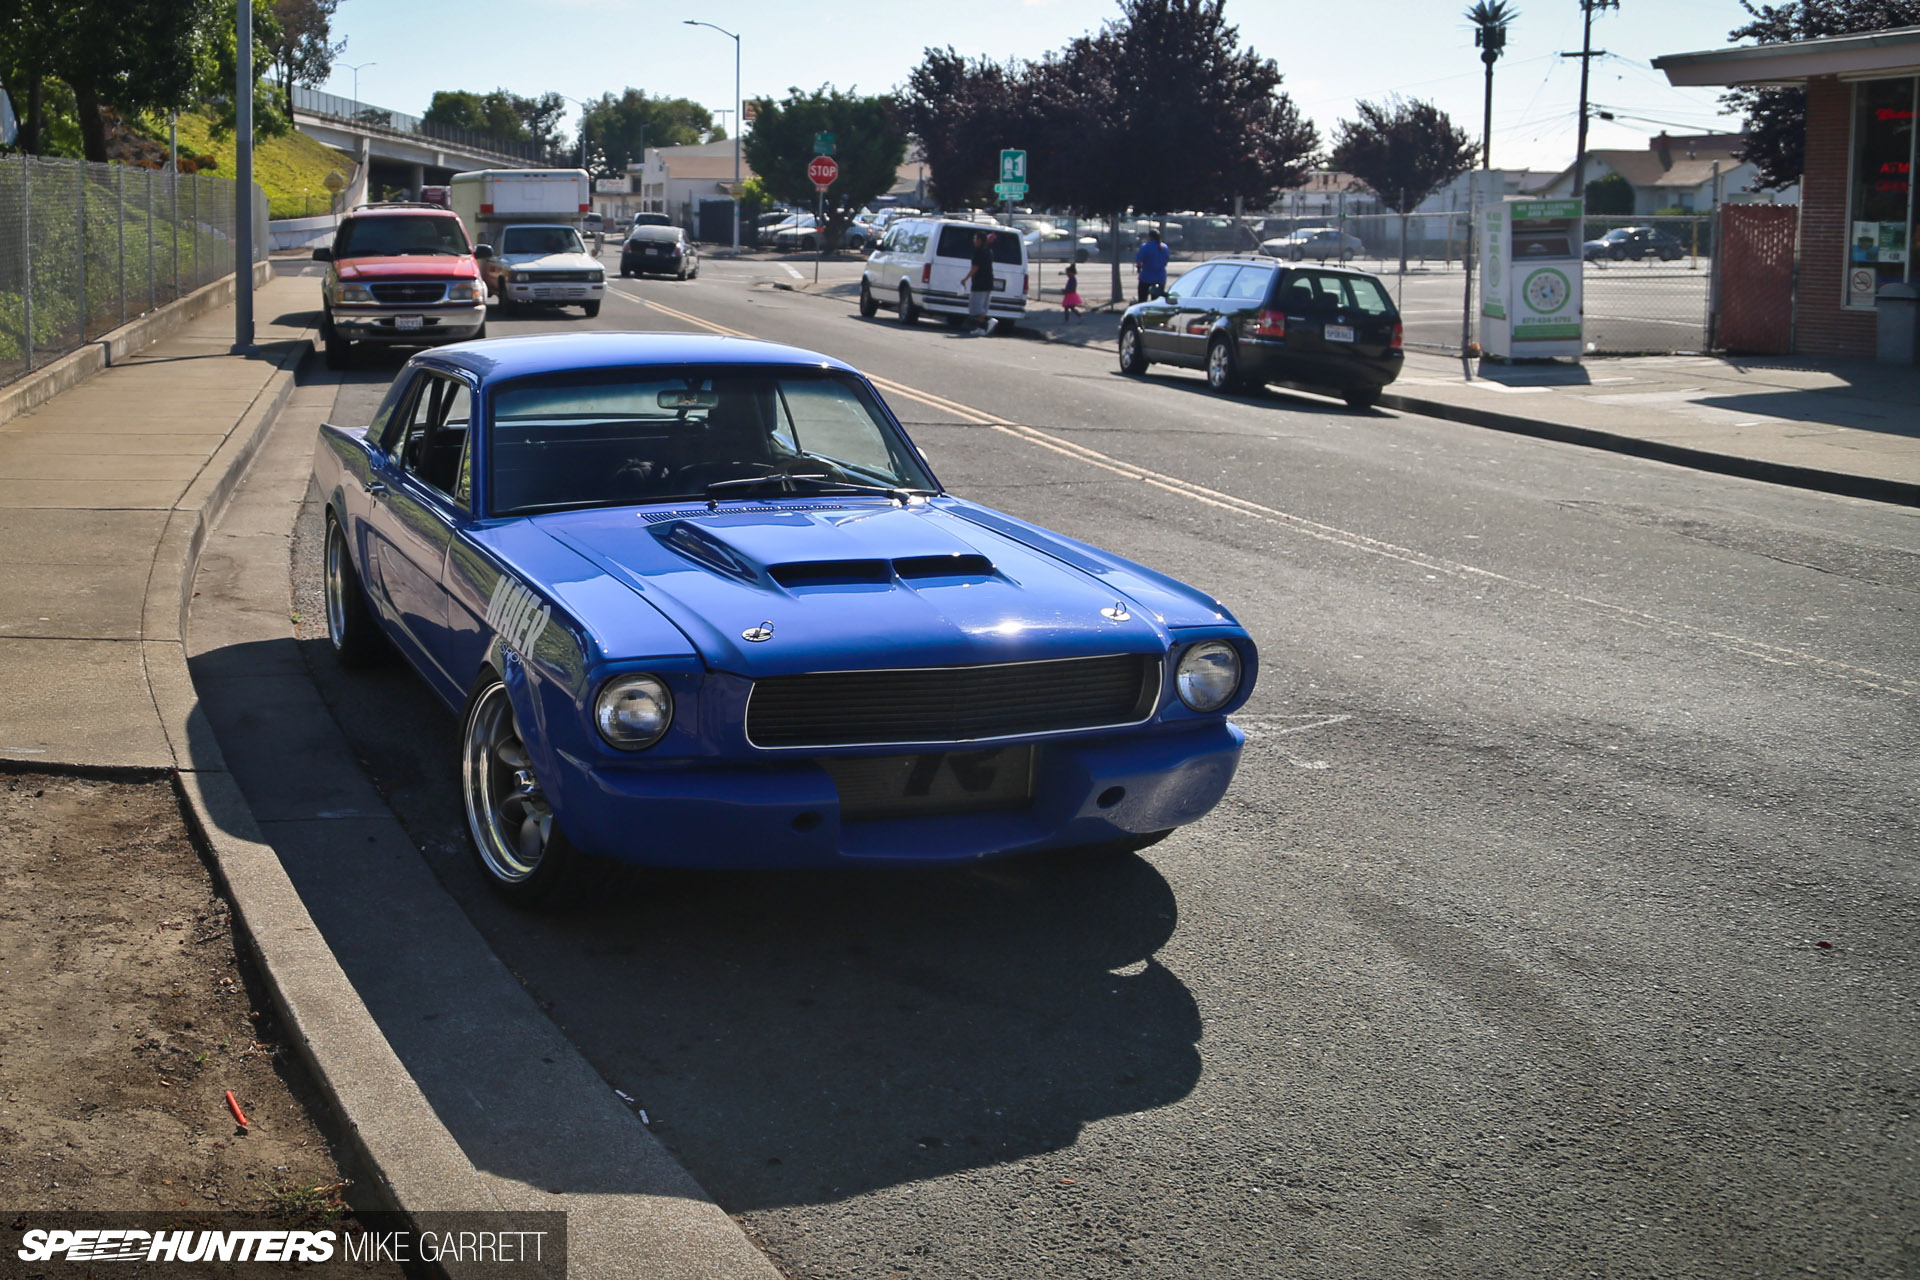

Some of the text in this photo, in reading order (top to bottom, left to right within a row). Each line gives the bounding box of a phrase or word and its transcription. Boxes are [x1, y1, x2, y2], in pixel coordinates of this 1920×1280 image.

[810, 165, 836, 177] STOP
[1880, 162, 1911, 174] ATM
[485, 574, 551, 660] MAIER
